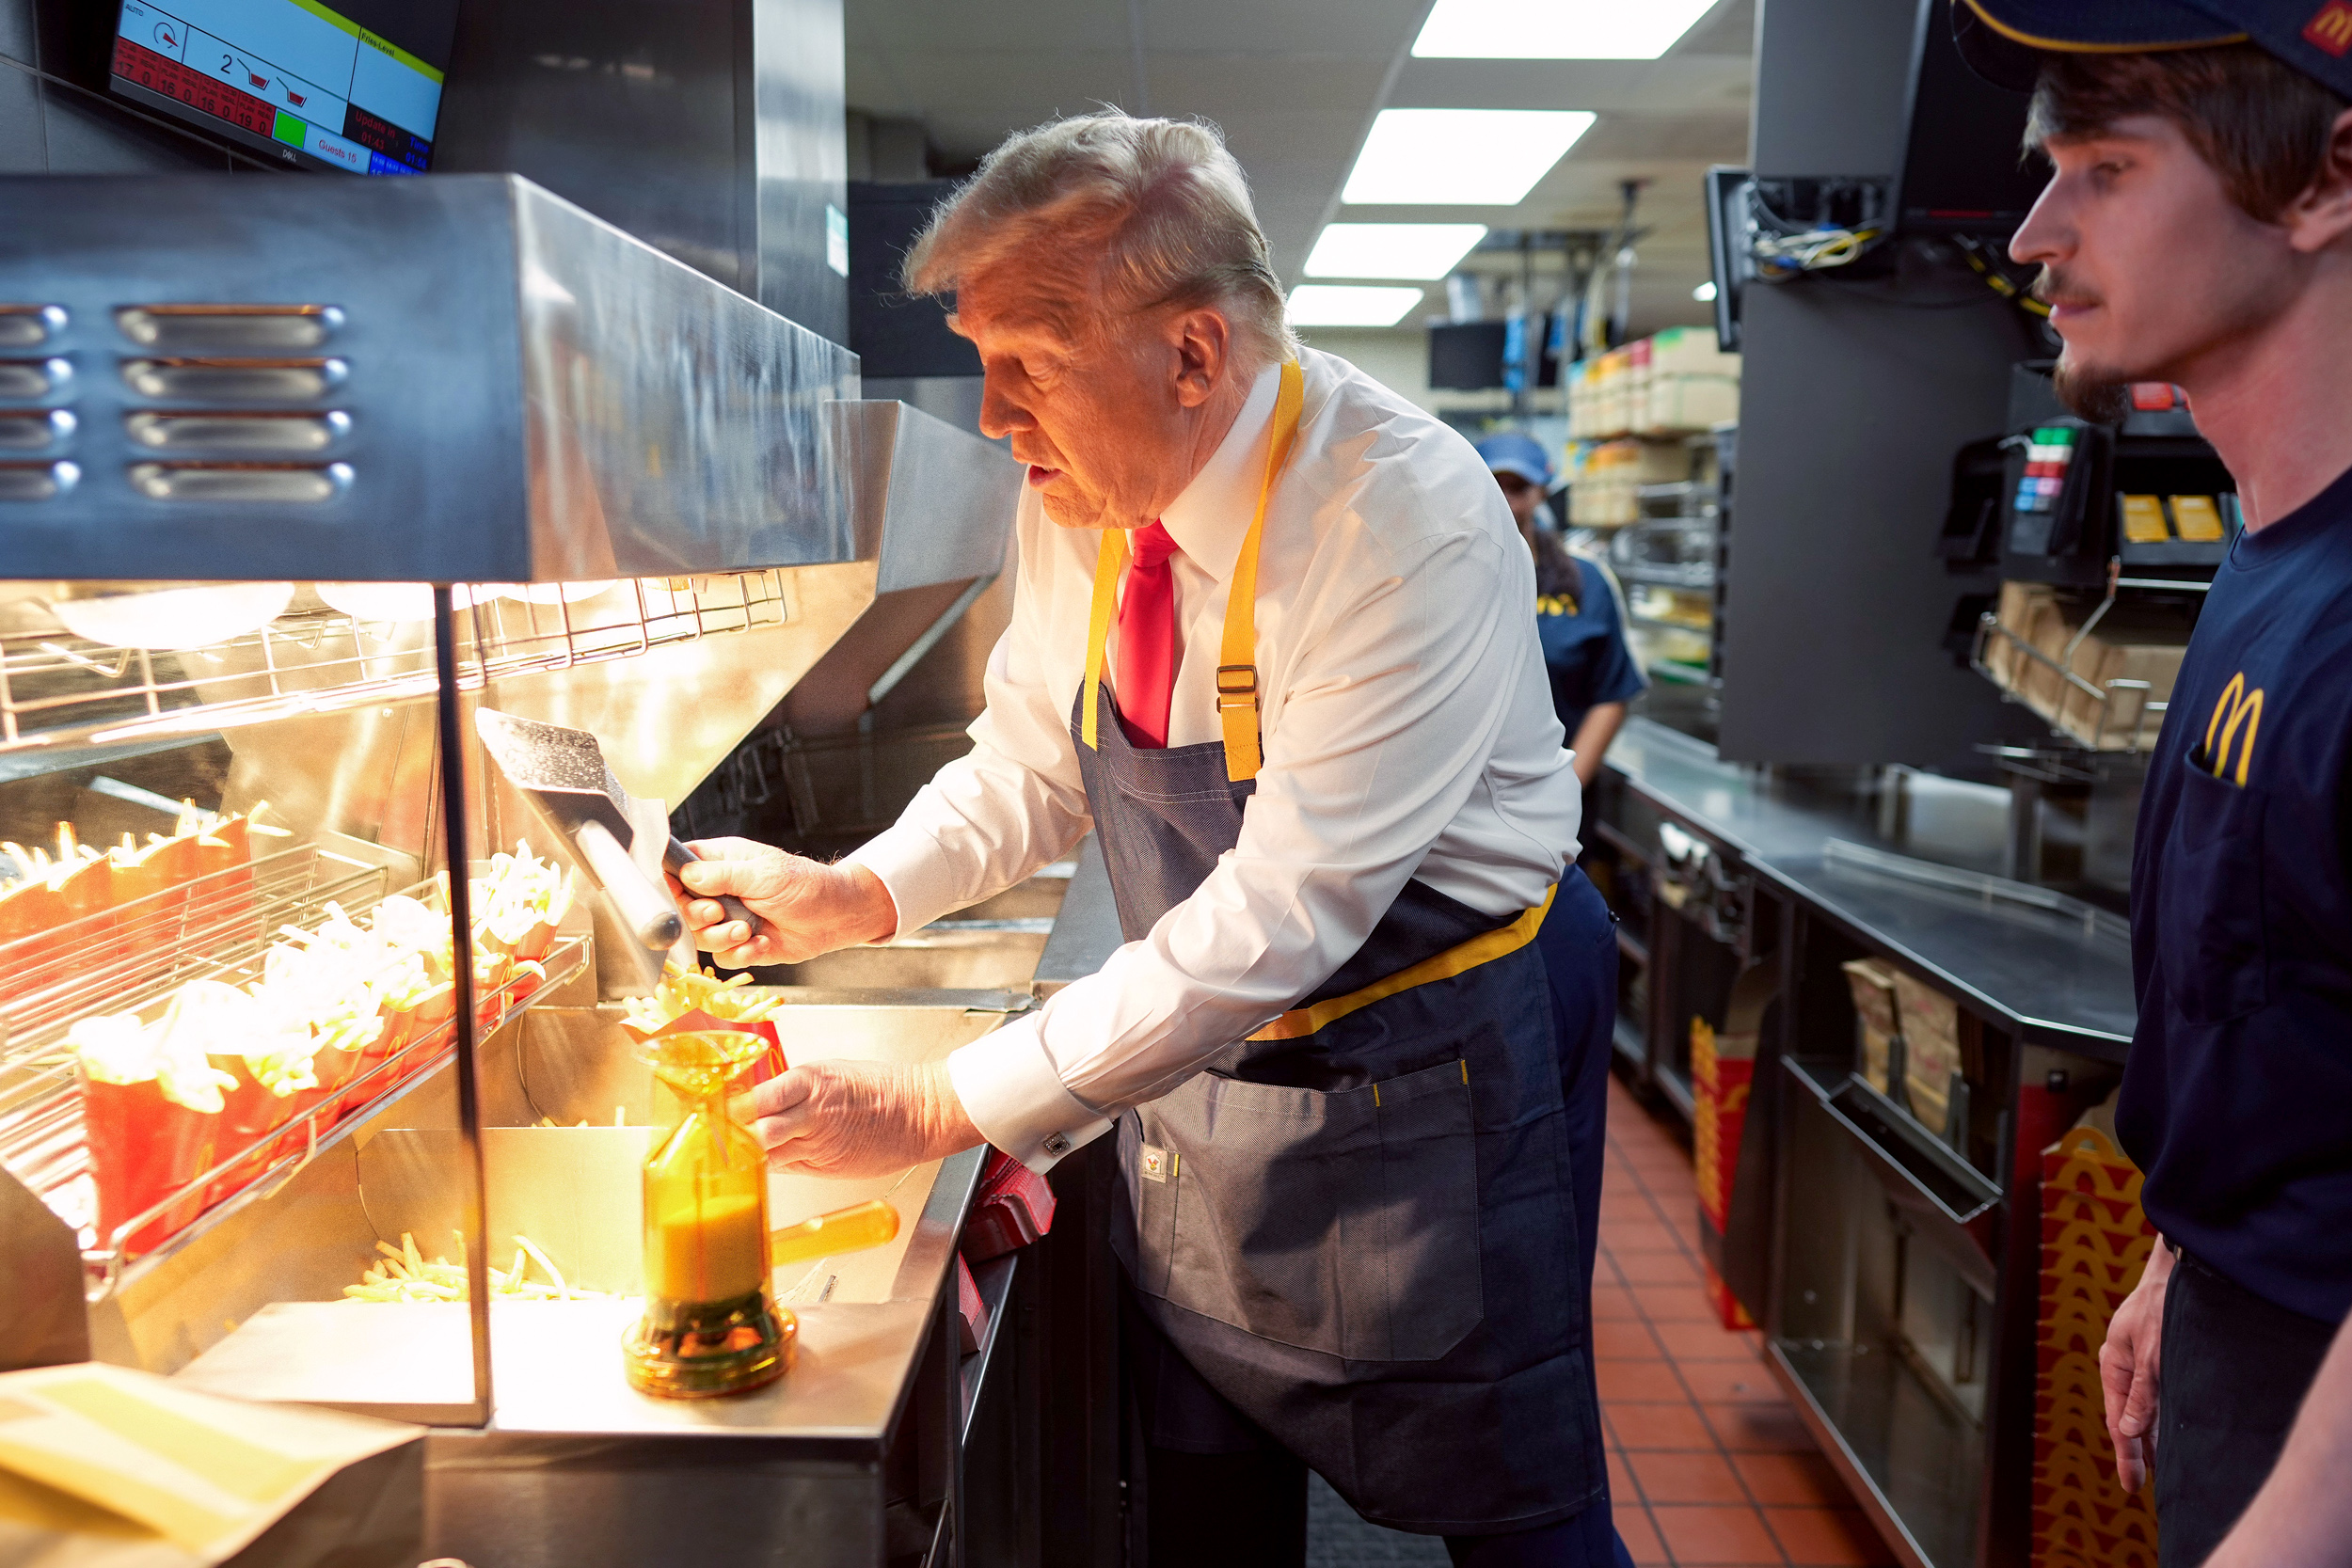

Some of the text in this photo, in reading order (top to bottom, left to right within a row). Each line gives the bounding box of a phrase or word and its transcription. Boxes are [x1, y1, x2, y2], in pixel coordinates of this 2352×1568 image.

[125, 4, 144, 17] AUTO
[220, 55, 233, 74] 2
[142, 71, 151, 86] 0
[182, 77, 198, 89] REAL
[161, 79, 193, 103] 16 0
[221, 94, 236, 106] REAL
[201, 97, 231, 119] 16 0
[258, 111, 272, 122] REAL
[239, 113, 267, 134] 19 0
[356, 110, 396, 139] Update in
[318, 139, 345, 159] Guests
[361, 132, 386, 151] 01:43
[409, 135, 430, 154] Time
[282, 149, 297, 164] DELL
